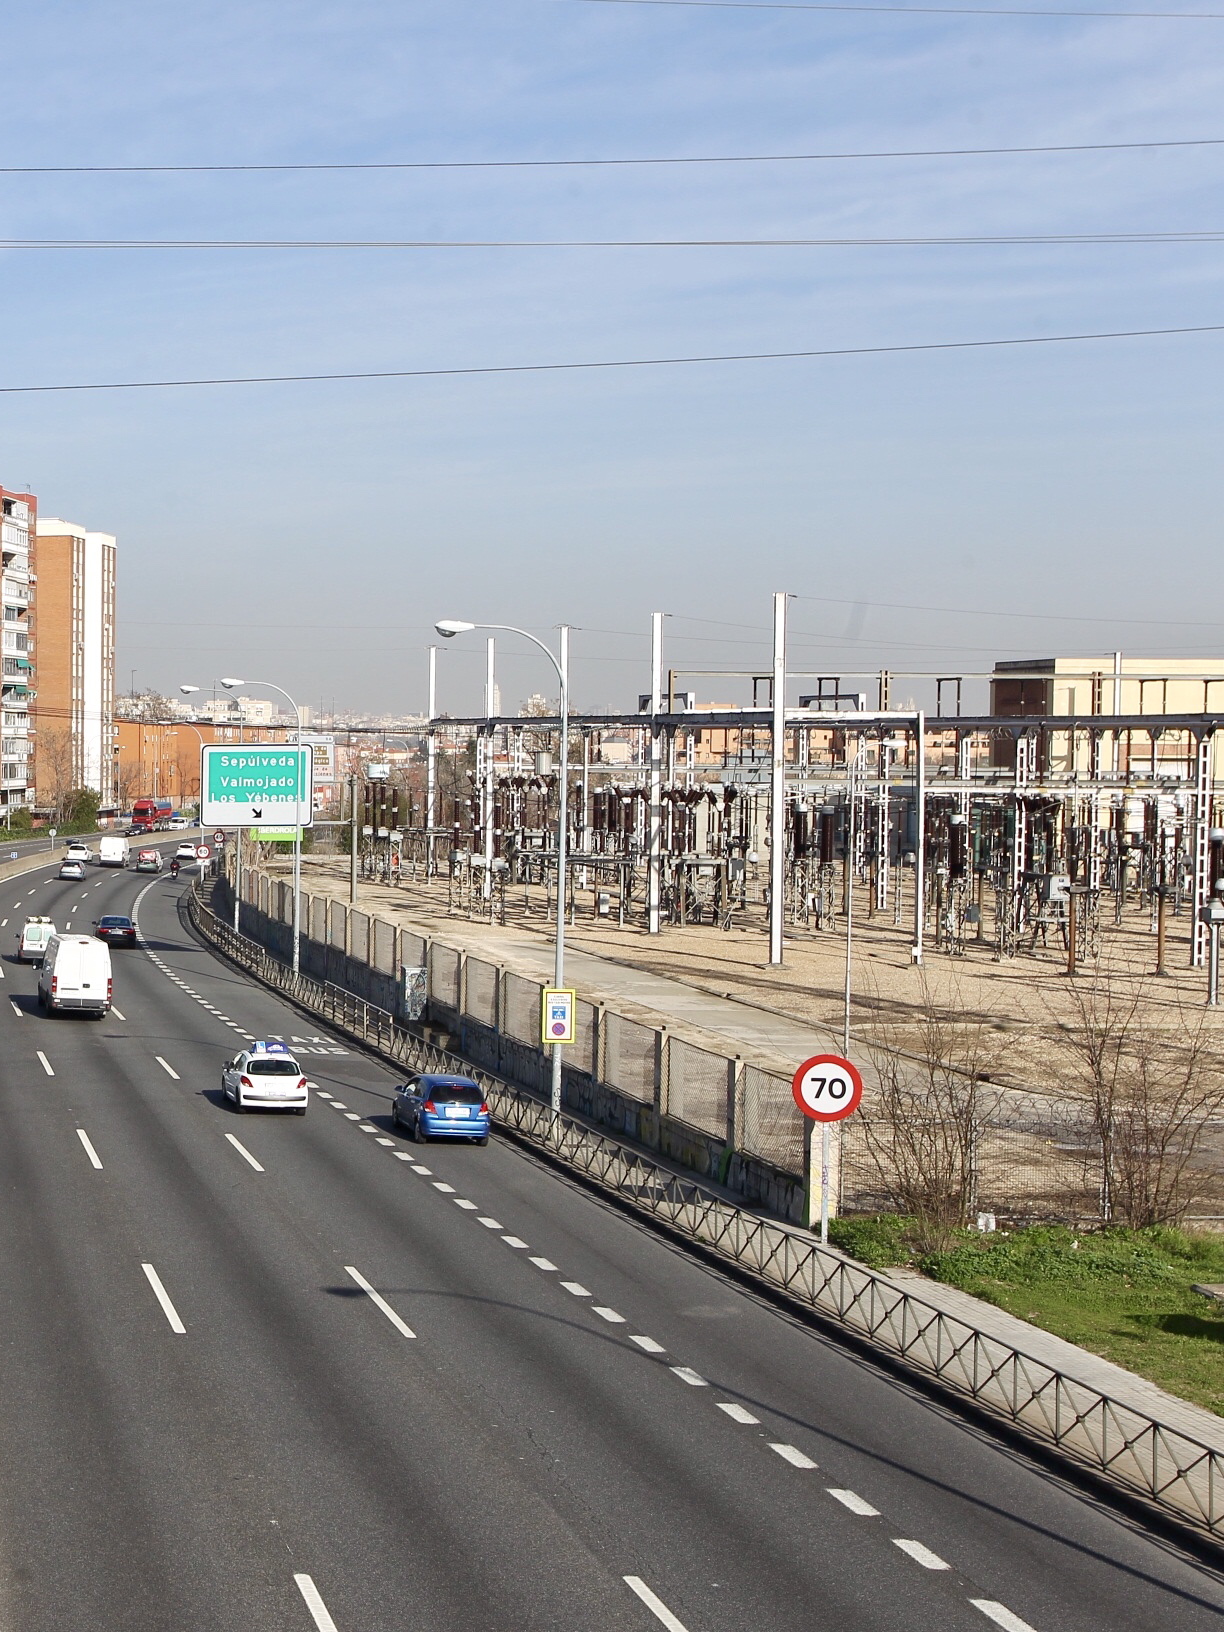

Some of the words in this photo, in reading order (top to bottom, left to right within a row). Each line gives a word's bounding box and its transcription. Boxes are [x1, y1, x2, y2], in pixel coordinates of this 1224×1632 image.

[221, 756, 295, 769] Sepúlveda
[220, 776, 294, 789] Valmojado
[211, 793, 236, 803] Los
[267, 1035, 337, 1044] TAXI
[287, 1046, 350, 1055] BUS
[811, 1077, 847, 1100] 70
